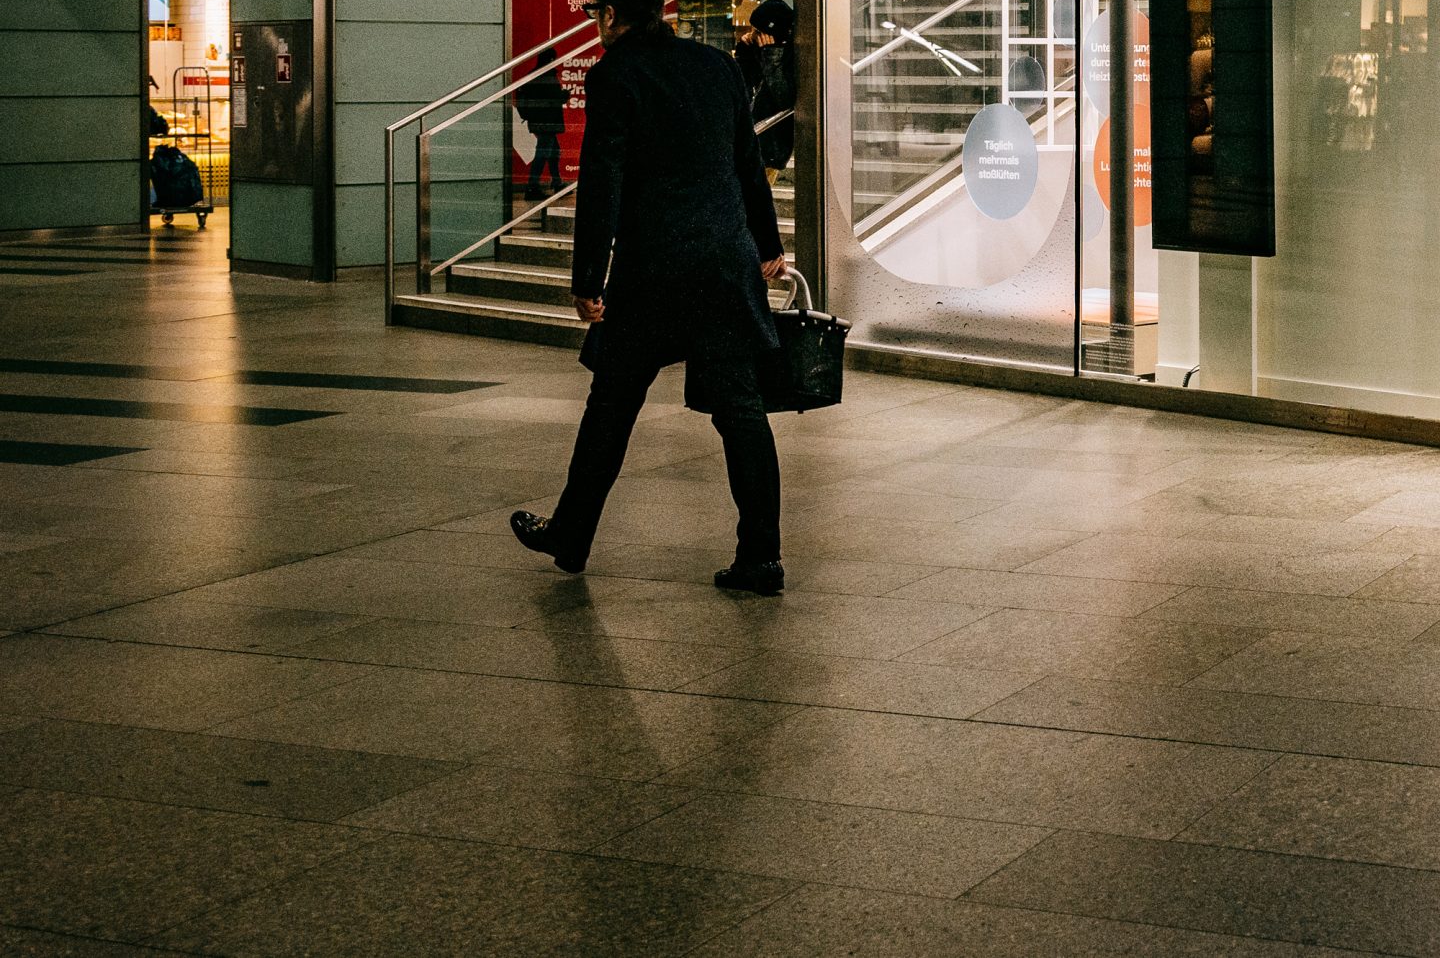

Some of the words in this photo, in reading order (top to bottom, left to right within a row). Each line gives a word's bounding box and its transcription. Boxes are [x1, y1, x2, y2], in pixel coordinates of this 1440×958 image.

[563, 56, 601, 68] Bowl
[984, 140, 1014, 153] Täglich
[978, 155, 1019, 166] mehrmals
